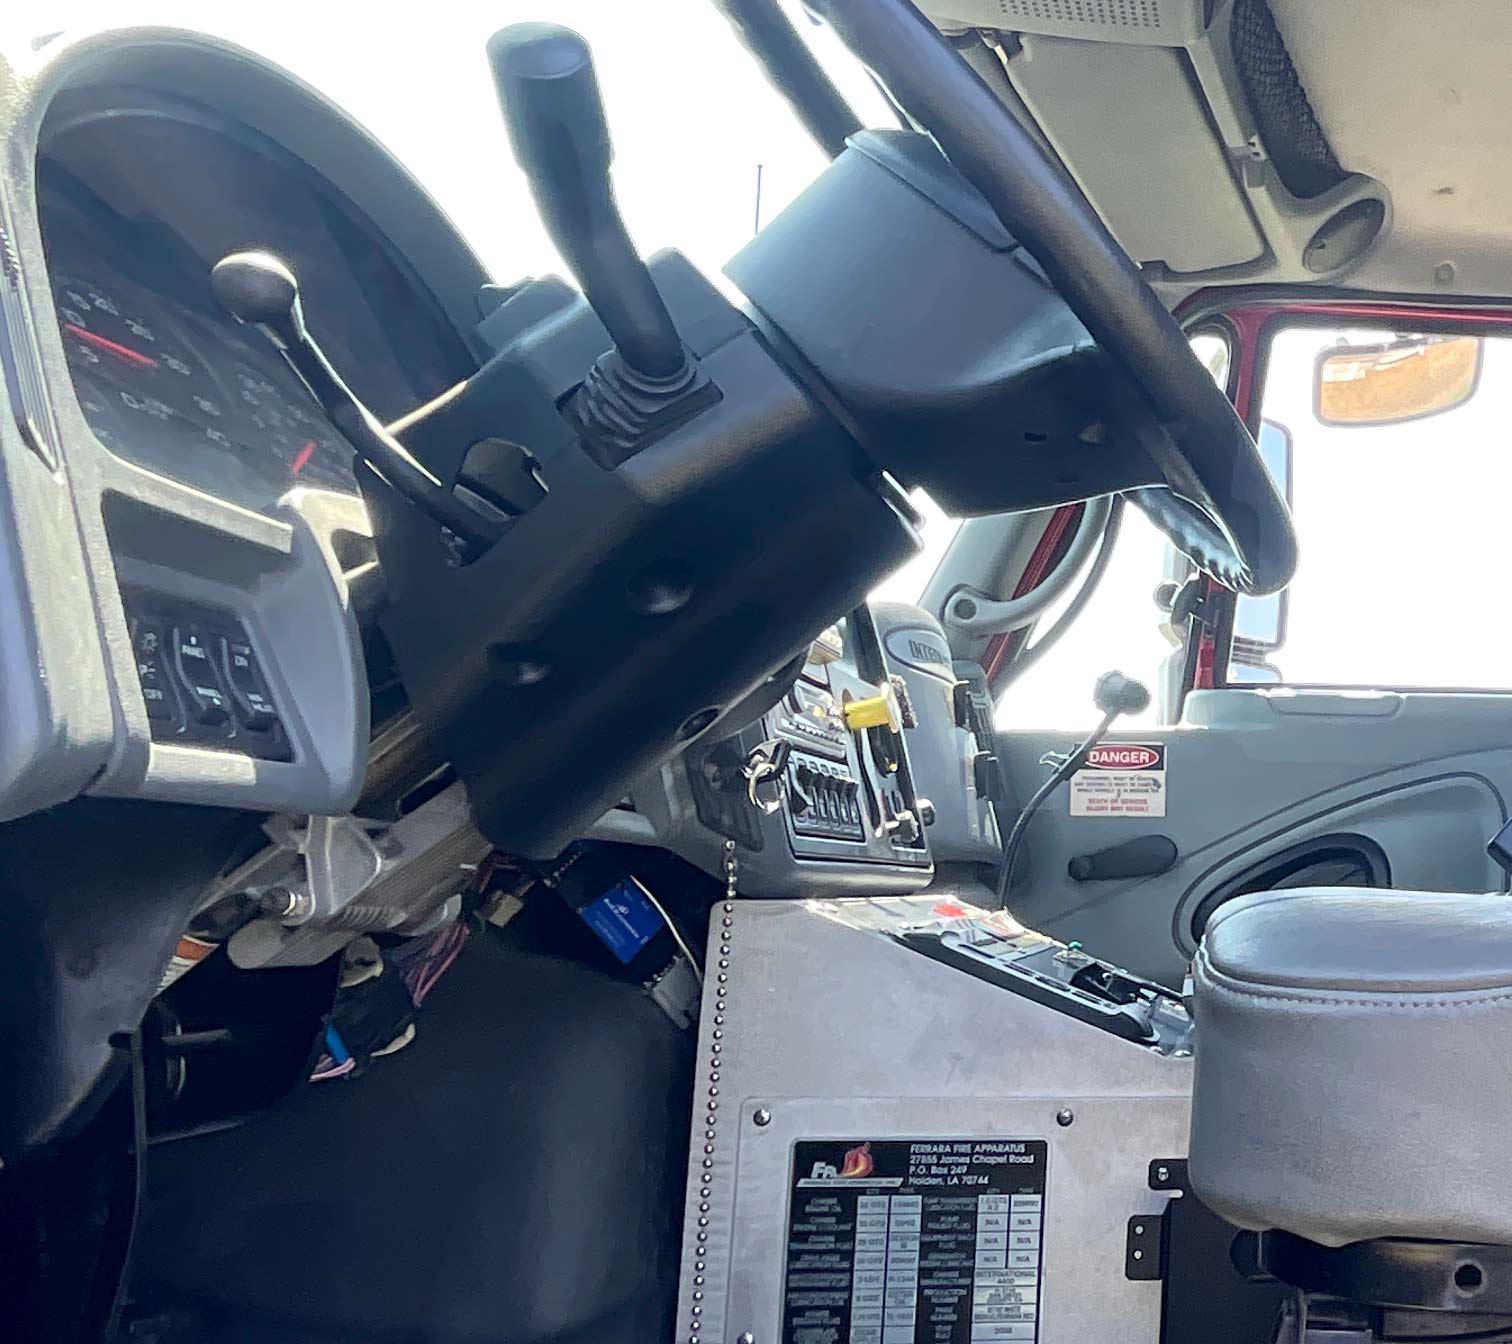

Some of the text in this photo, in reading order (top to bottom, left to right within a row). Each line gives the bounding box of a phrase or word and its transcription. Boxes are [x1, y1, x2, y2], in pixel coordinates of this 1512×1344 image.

[1089, 751, 1150, 764] DANGER
[910, 1144, 1026, 1154] FERRARA FIRE APPARATUS
[939, 1155, 970, 1164] James
[972, 1155, 1007, 1166] Chapel
[1008, 1155, 1034, 1164] Road
[930, 1165, 949, 1174] Box
[947, 1176, 959, 1185] LA
[975, 1270, 1035, 1278] INTERNATIONAL
